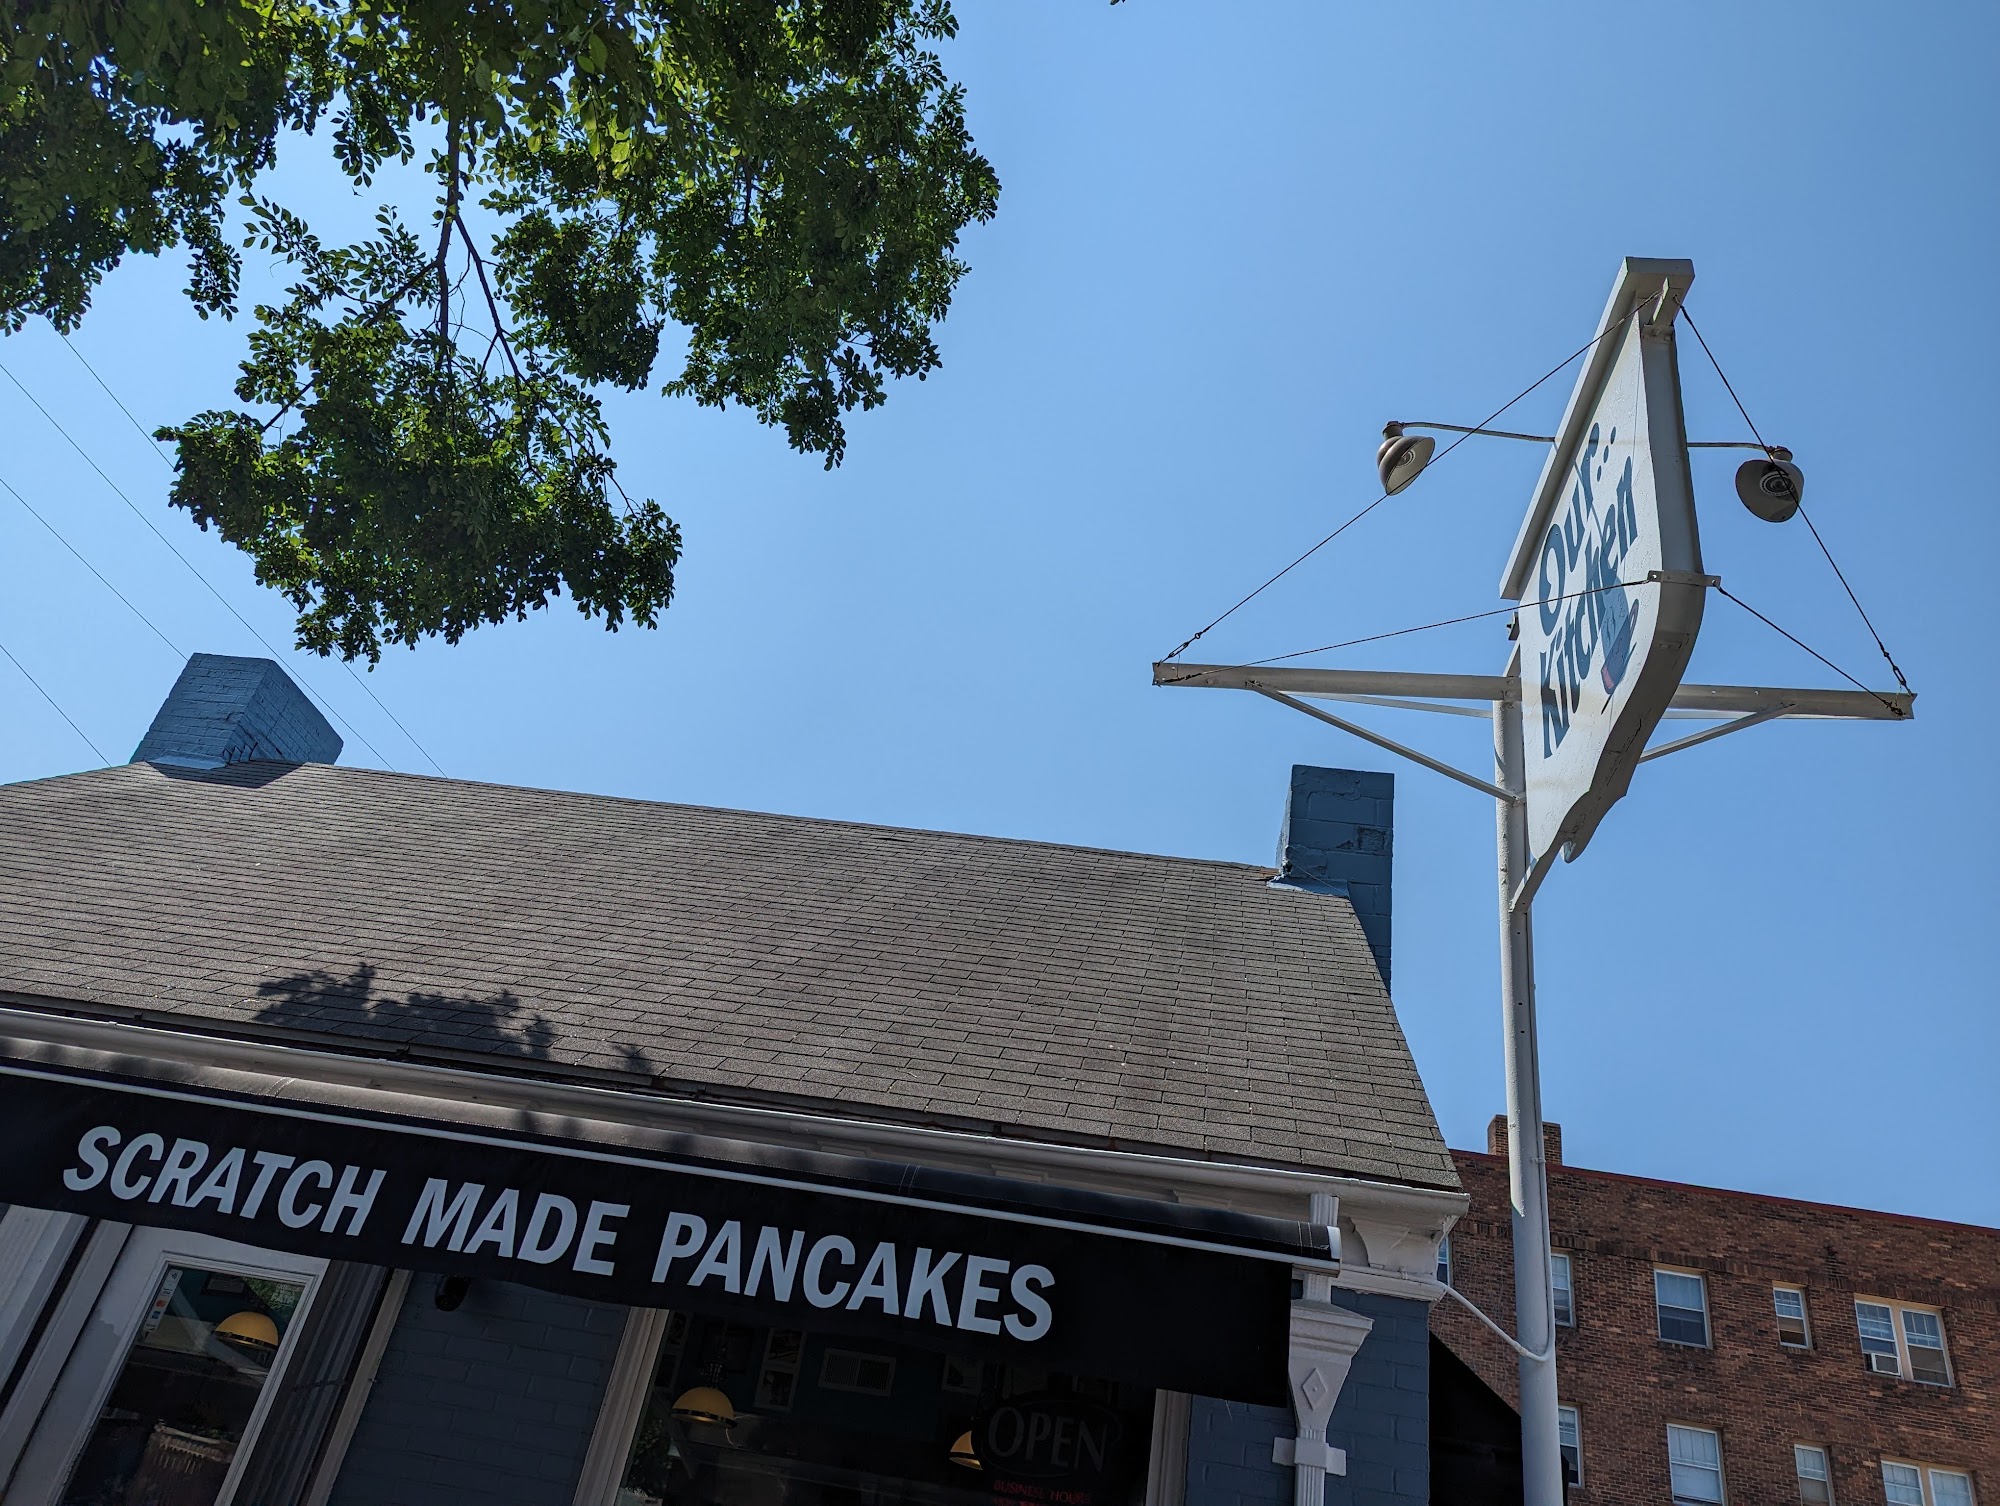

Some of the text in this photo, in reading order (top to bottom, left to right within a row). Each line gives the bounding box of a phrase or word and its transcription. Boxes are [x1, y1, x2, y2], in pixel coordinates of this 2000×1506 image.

[1540, 456, 1638, 760] Kitchen
[63, 1125, 1056, 1342] SCRATCH MADE PANCAKES
[987, 1406, 1108, 1472] OPEN
